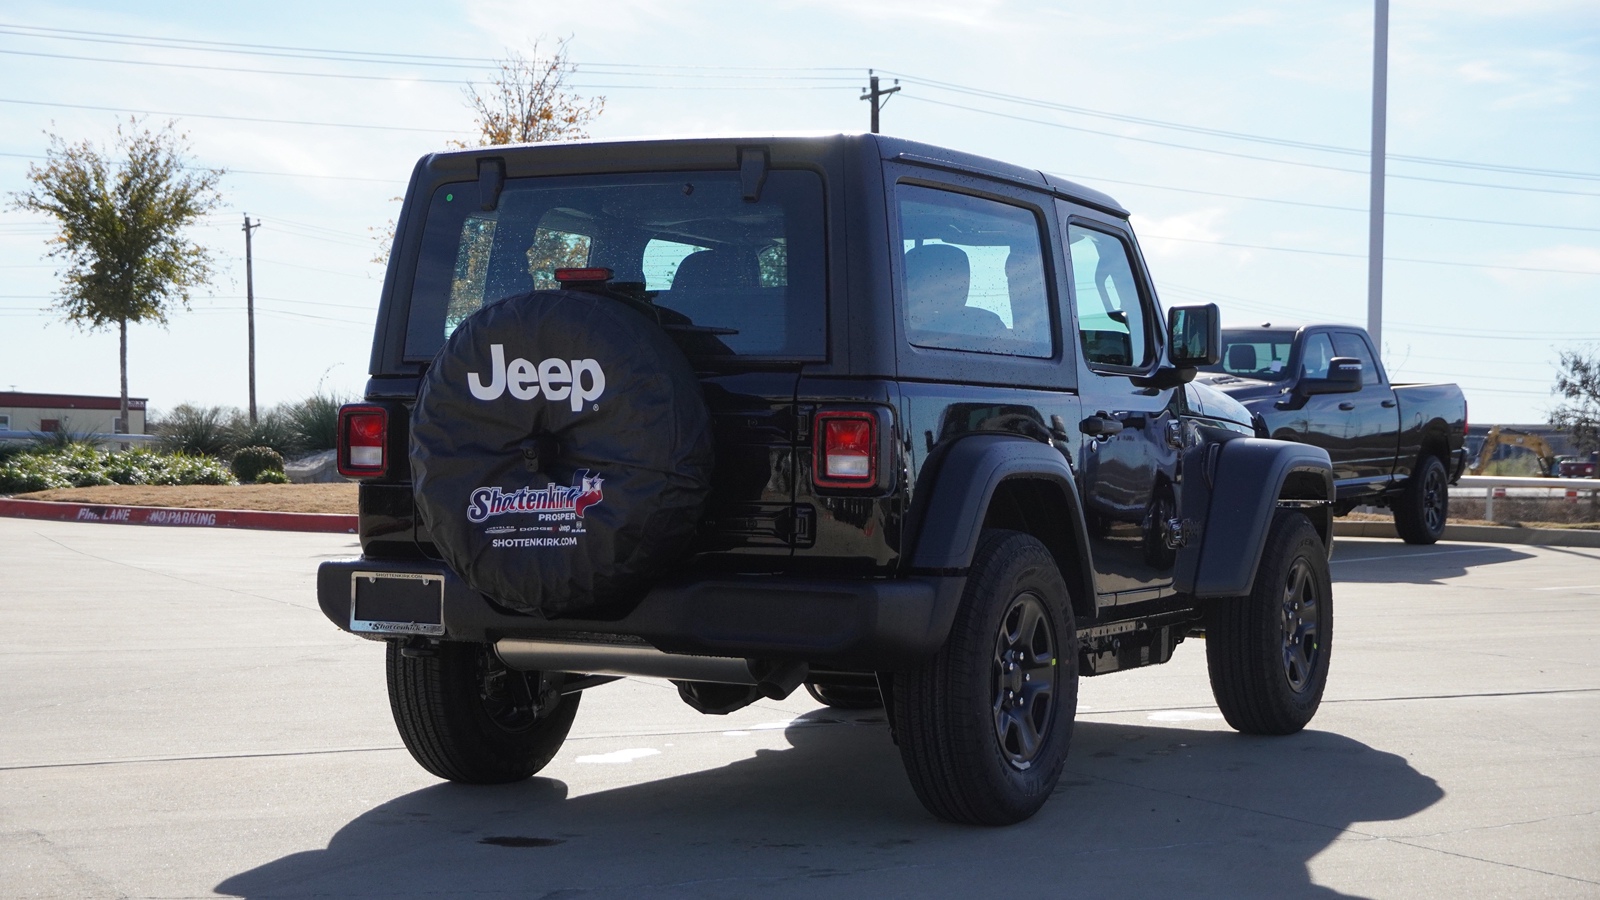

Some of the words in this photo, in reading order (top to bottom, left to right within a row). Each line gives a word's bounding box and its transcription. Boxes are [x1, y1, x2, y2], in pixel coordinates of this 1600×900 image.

[467, 343, 606, 412] Jeep
[467, 483, 580, 523] Shottenkirk
[102, 509, 131, 521] LANE
[150, 511, 166, 523] NO
[167, 512, 216, 525] PARKING
[538, 513, 576, 522] PROSPER
[492, 537, 578, 548] SHOTTENKIRK.COM
